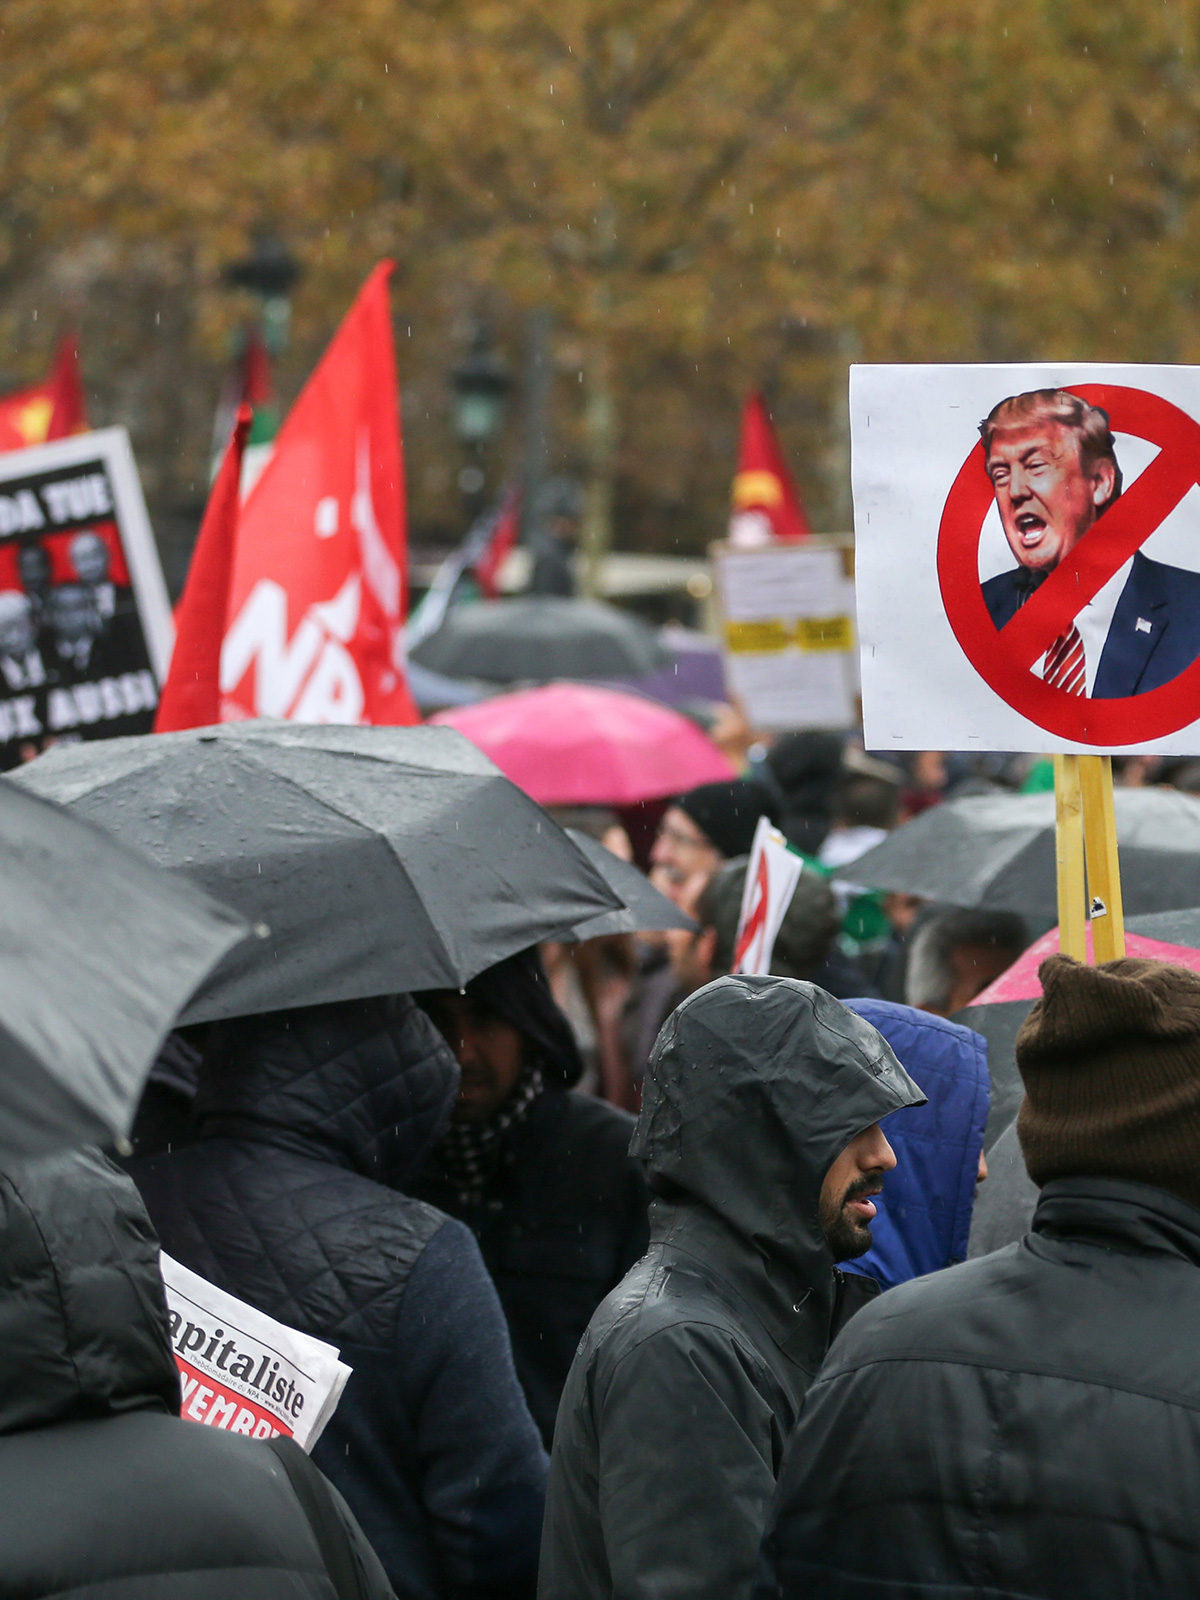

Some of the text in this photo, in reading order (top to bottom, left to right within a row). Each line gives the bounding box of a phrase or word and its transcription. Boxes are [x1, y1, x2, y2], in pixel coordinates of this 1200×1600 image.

[47, 669, 158, 732] AUSSI
[181, 1371, 281, 1440] VEMBR
[247, 1388, 260, 1400] NPA
